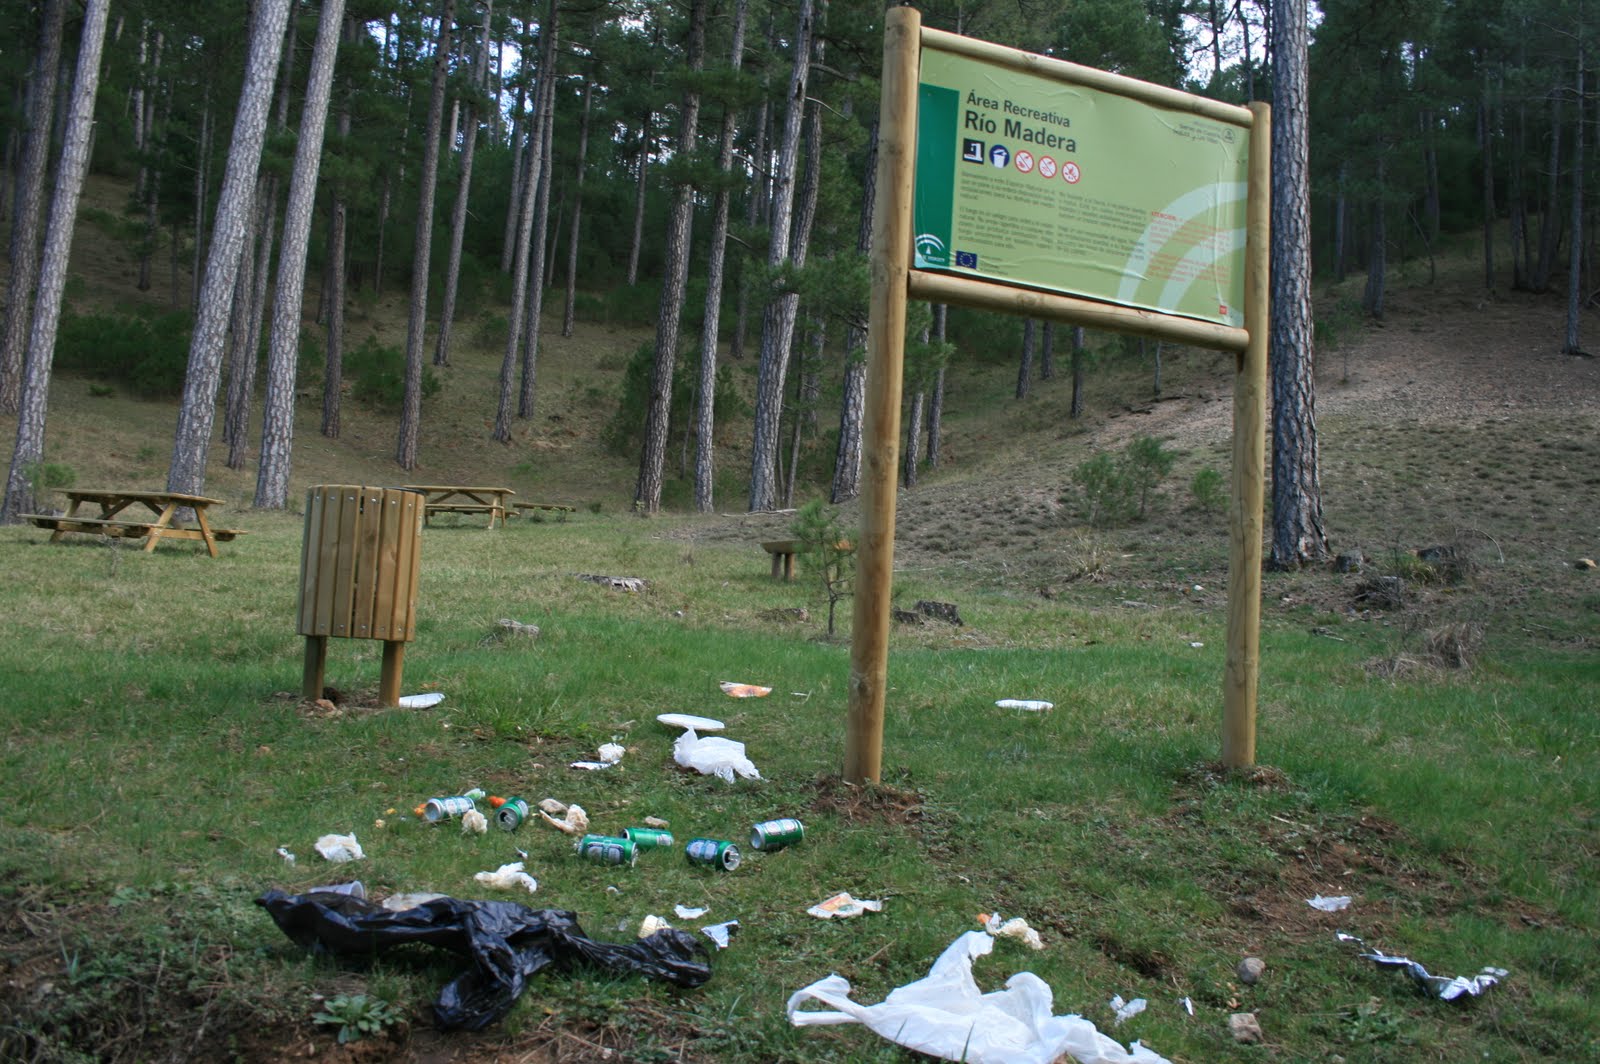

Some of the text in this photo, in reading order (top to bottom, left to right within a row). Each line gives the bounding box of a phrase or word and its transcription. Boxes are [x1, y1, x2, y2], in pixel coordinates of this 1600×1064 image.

[966, 89, 1071, 128] Área Recreativa
[964, 110, 1077, 153] Río Madera
